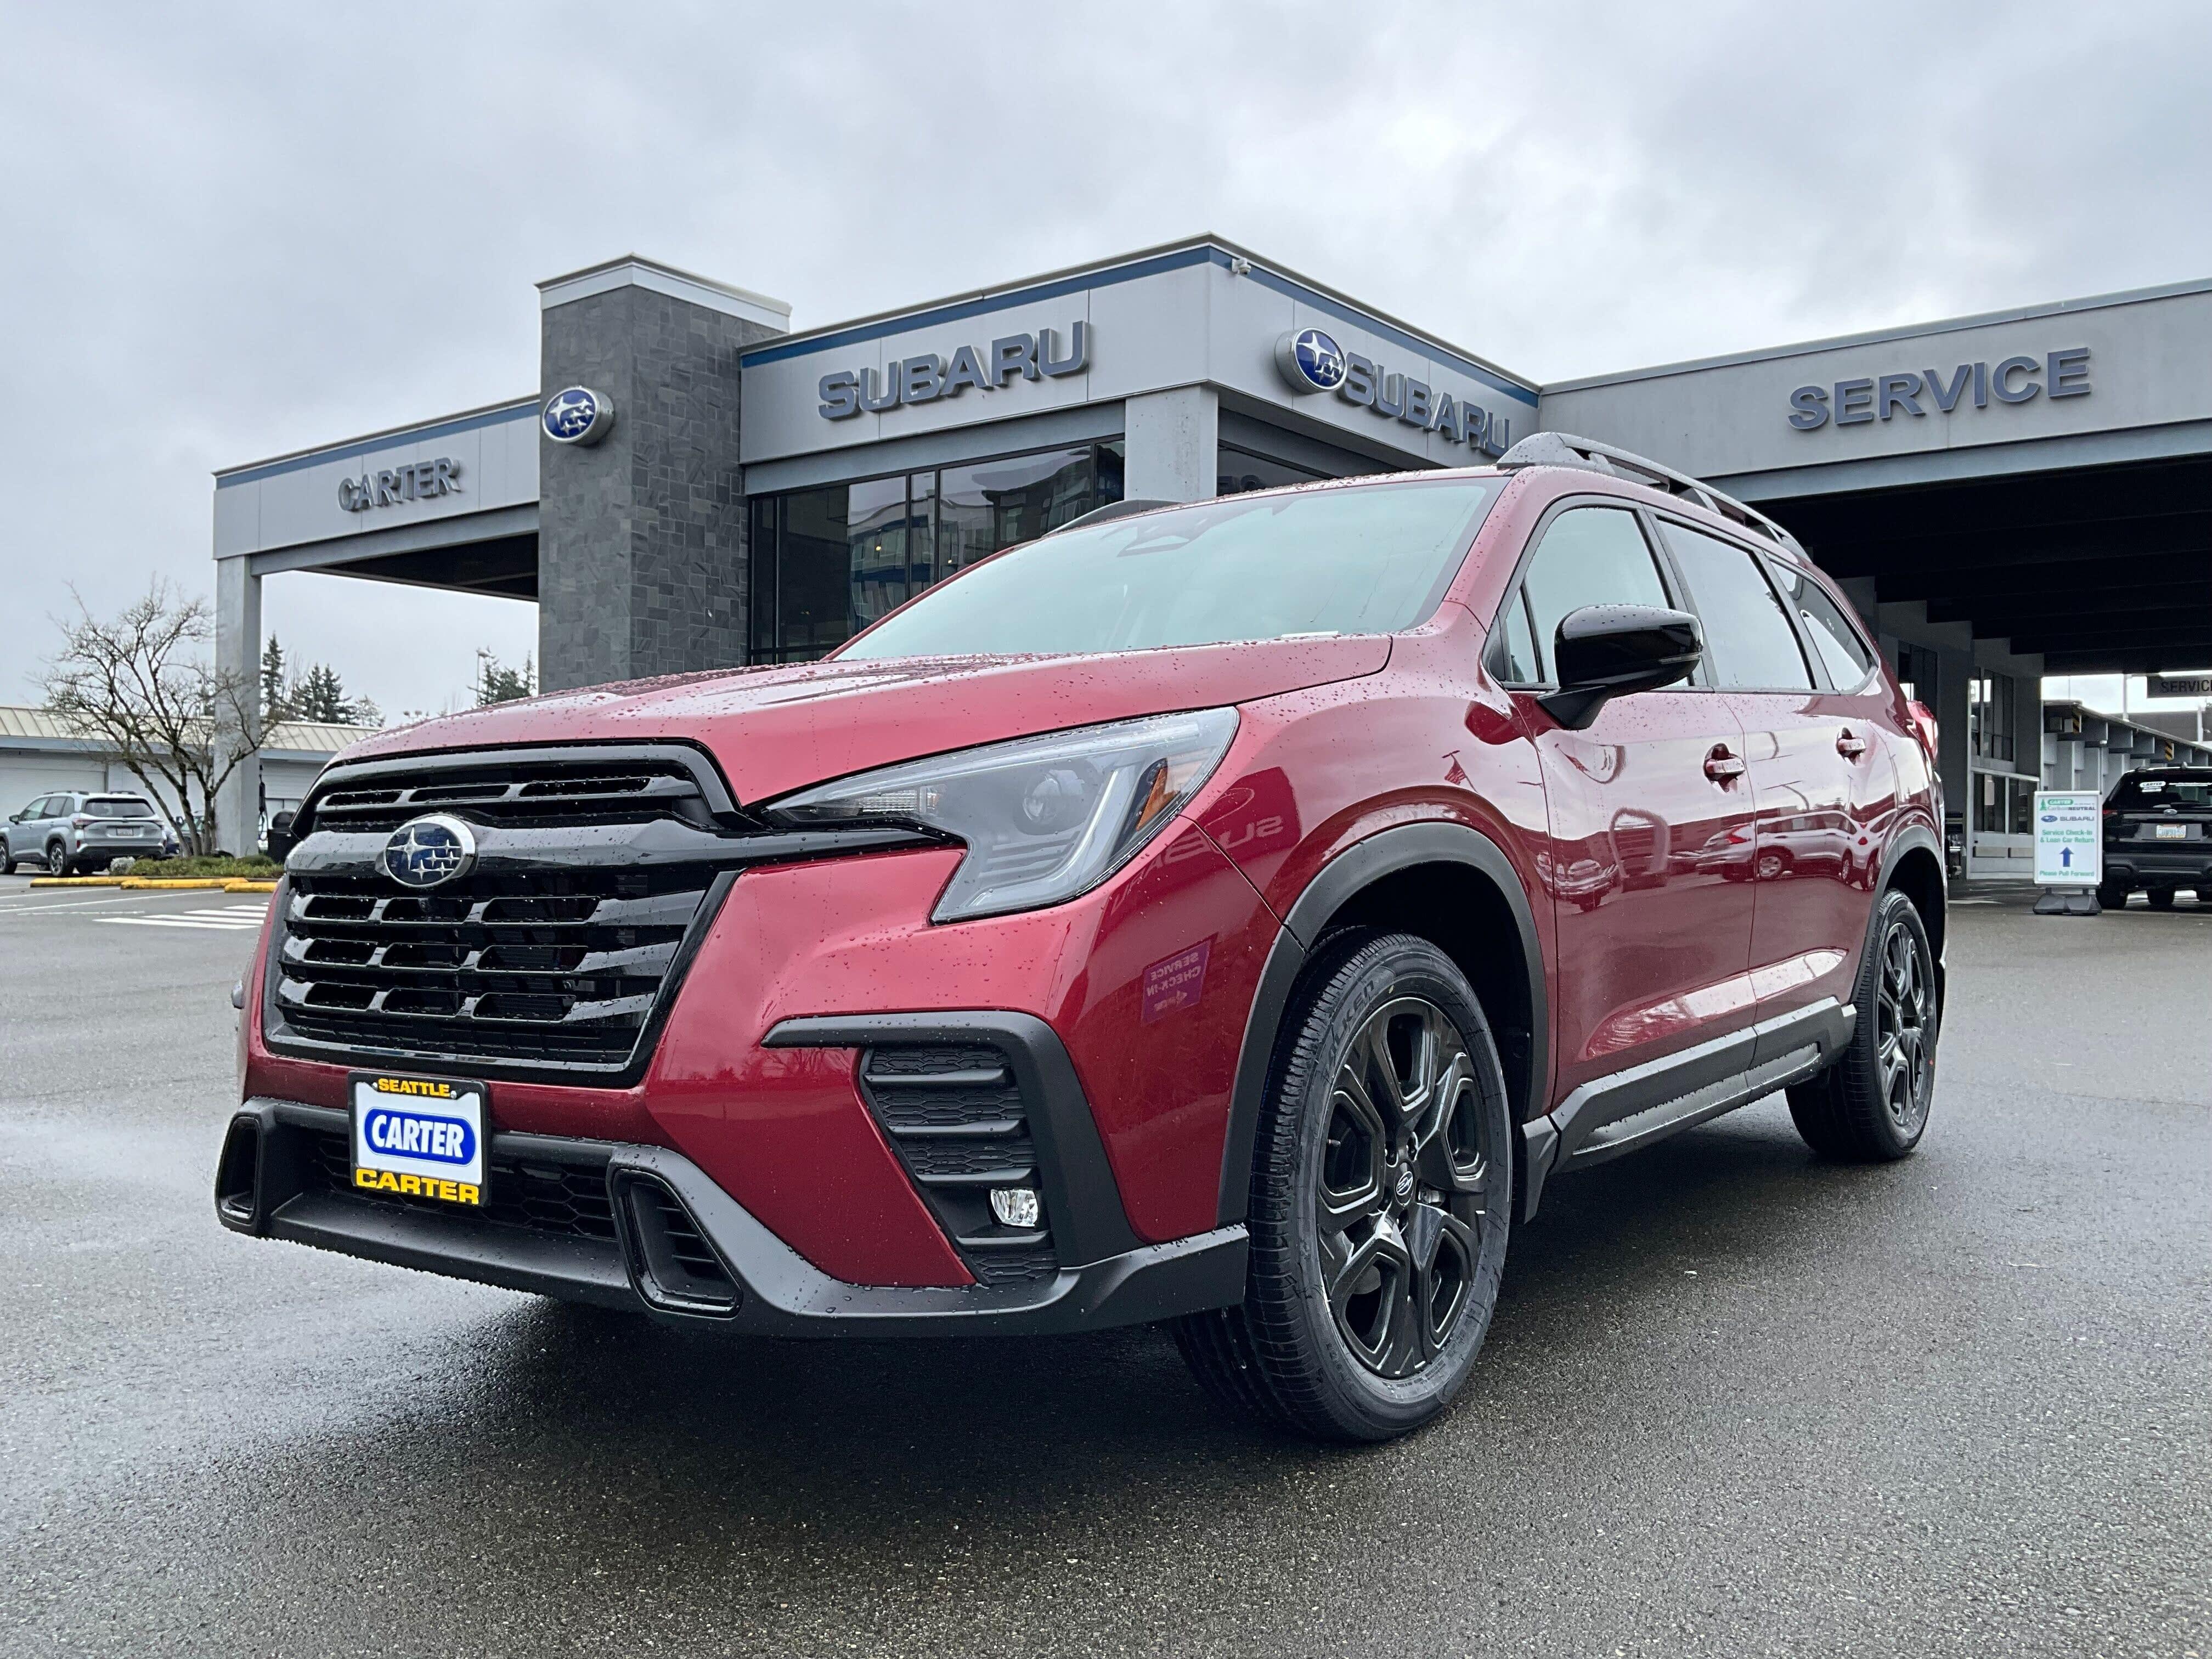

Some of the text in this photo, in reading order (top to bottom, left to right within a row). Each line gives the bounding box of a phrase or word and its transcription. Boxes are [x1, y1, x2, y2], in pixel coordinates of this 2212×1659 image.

[818, 320, 1089, 421] SUBARU
[1787, 347, 2091, 430] SERVICE
[1342, 351, 1510, 458] SUBARU
[338, 457, 460, 511] CARTER
[2160, 680, 2212, 693] SERVIC
[377, 1078, 451, 1098] SEATTLE
[371, 1114, 465, 1158] CARTER
[356, 1168, 479, 1205] CARTER
